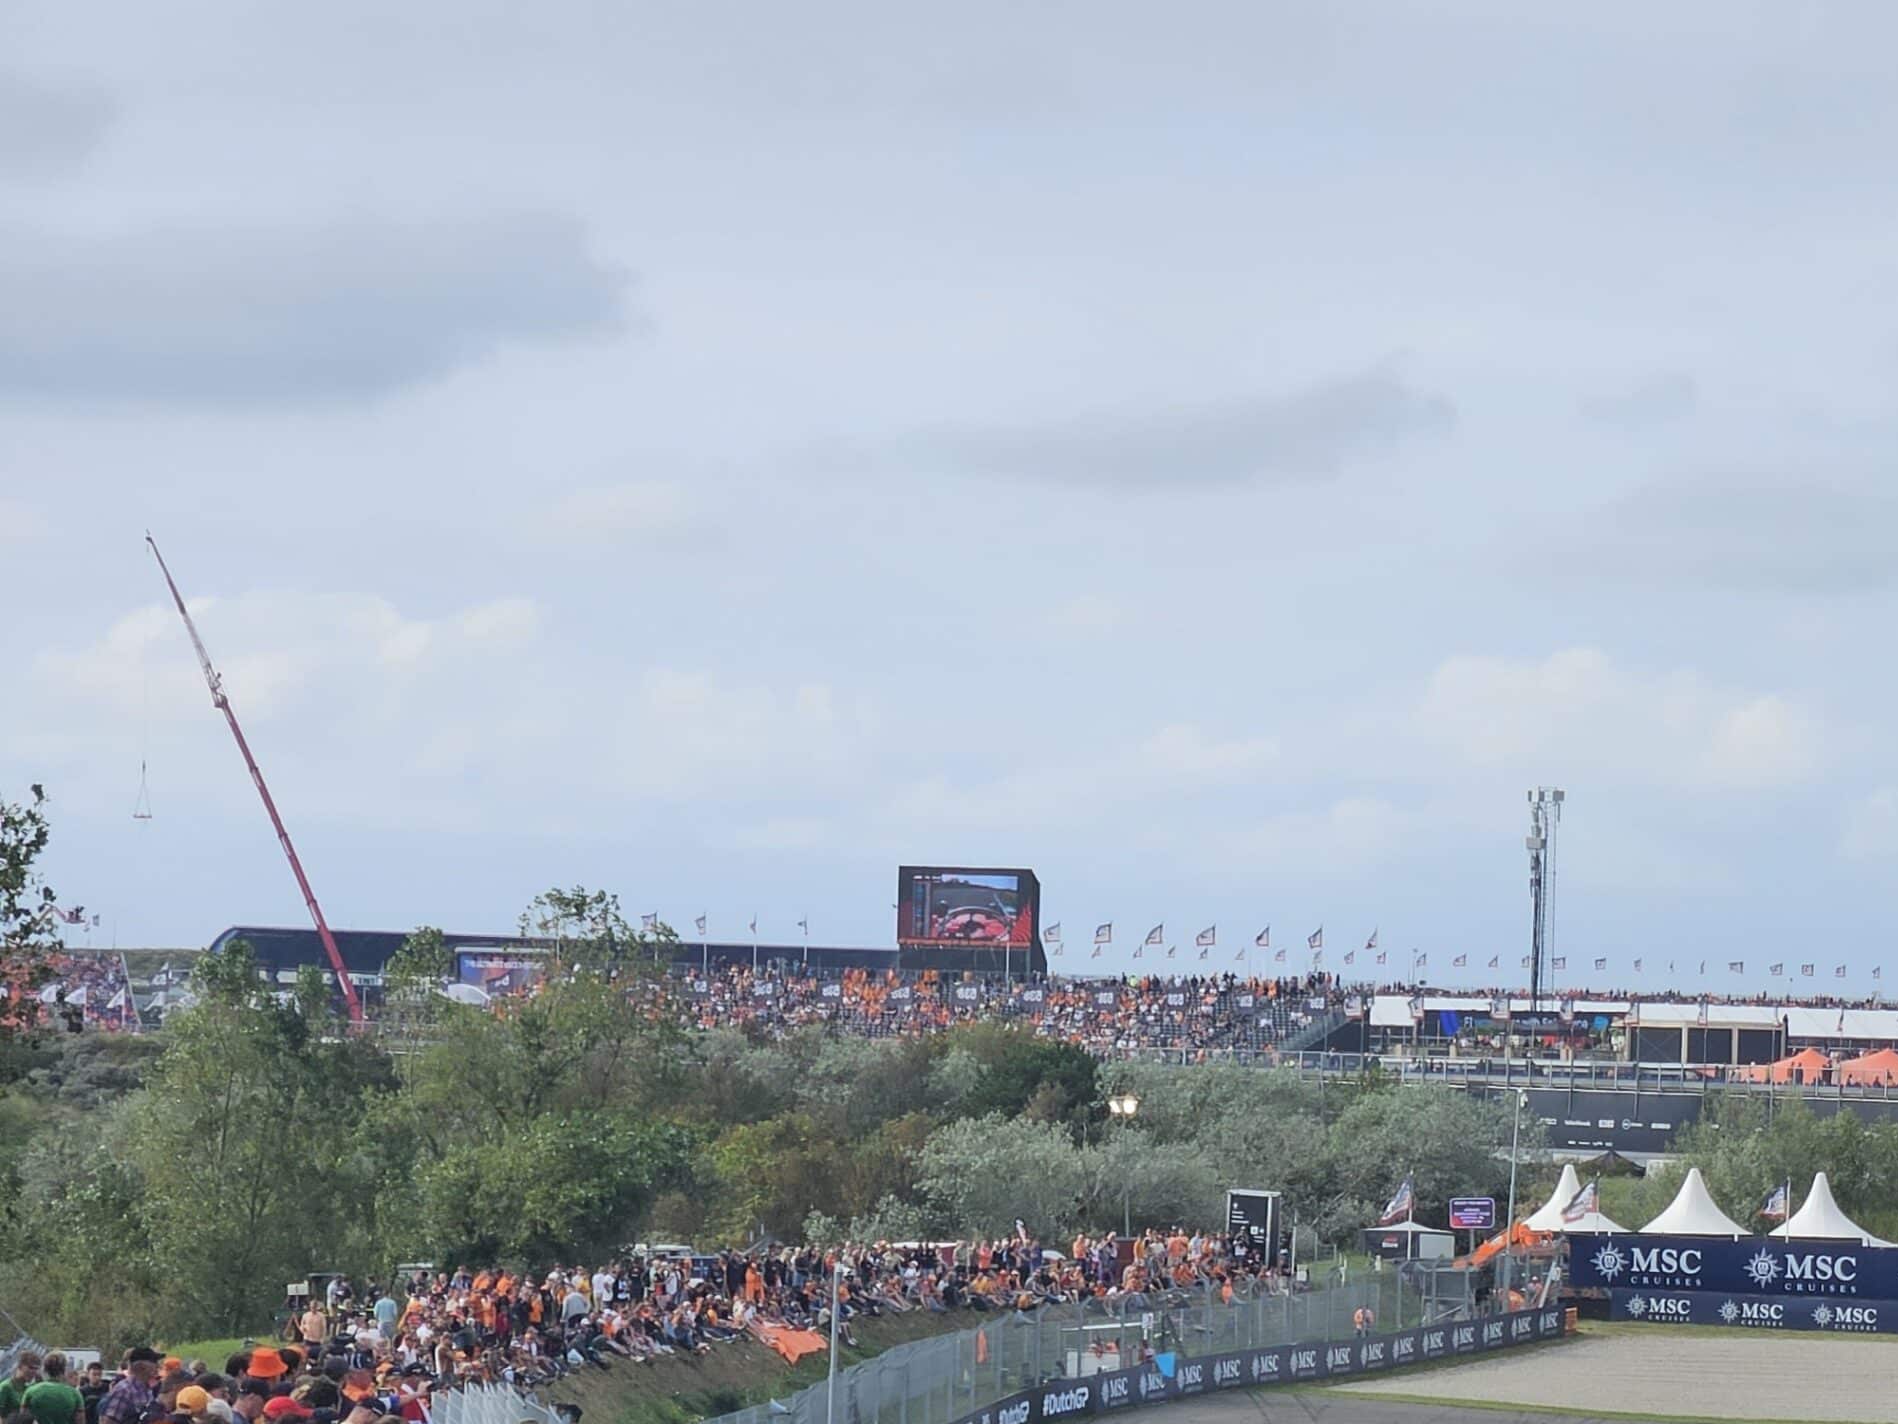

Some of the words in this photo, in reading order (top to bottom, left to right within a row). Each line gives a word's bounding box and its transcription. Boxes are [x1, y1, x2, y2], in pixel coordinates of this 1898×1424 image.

[1630, 1247, 1702, 1275] MSC
[1784, 1253, 1857, 1281] MSC
[1630, 1275, 1702, 1286] CRUISES
[1784, 1282, 1857, 1294] CRUISES
[1649, 1297, 1691, 1315] MSC
[1741, 1303, 1783, 1320] MSC
[1834, 1307, 1877, 1324] MSC
[1042, 1387, 1089, 1416] #DutchGP
